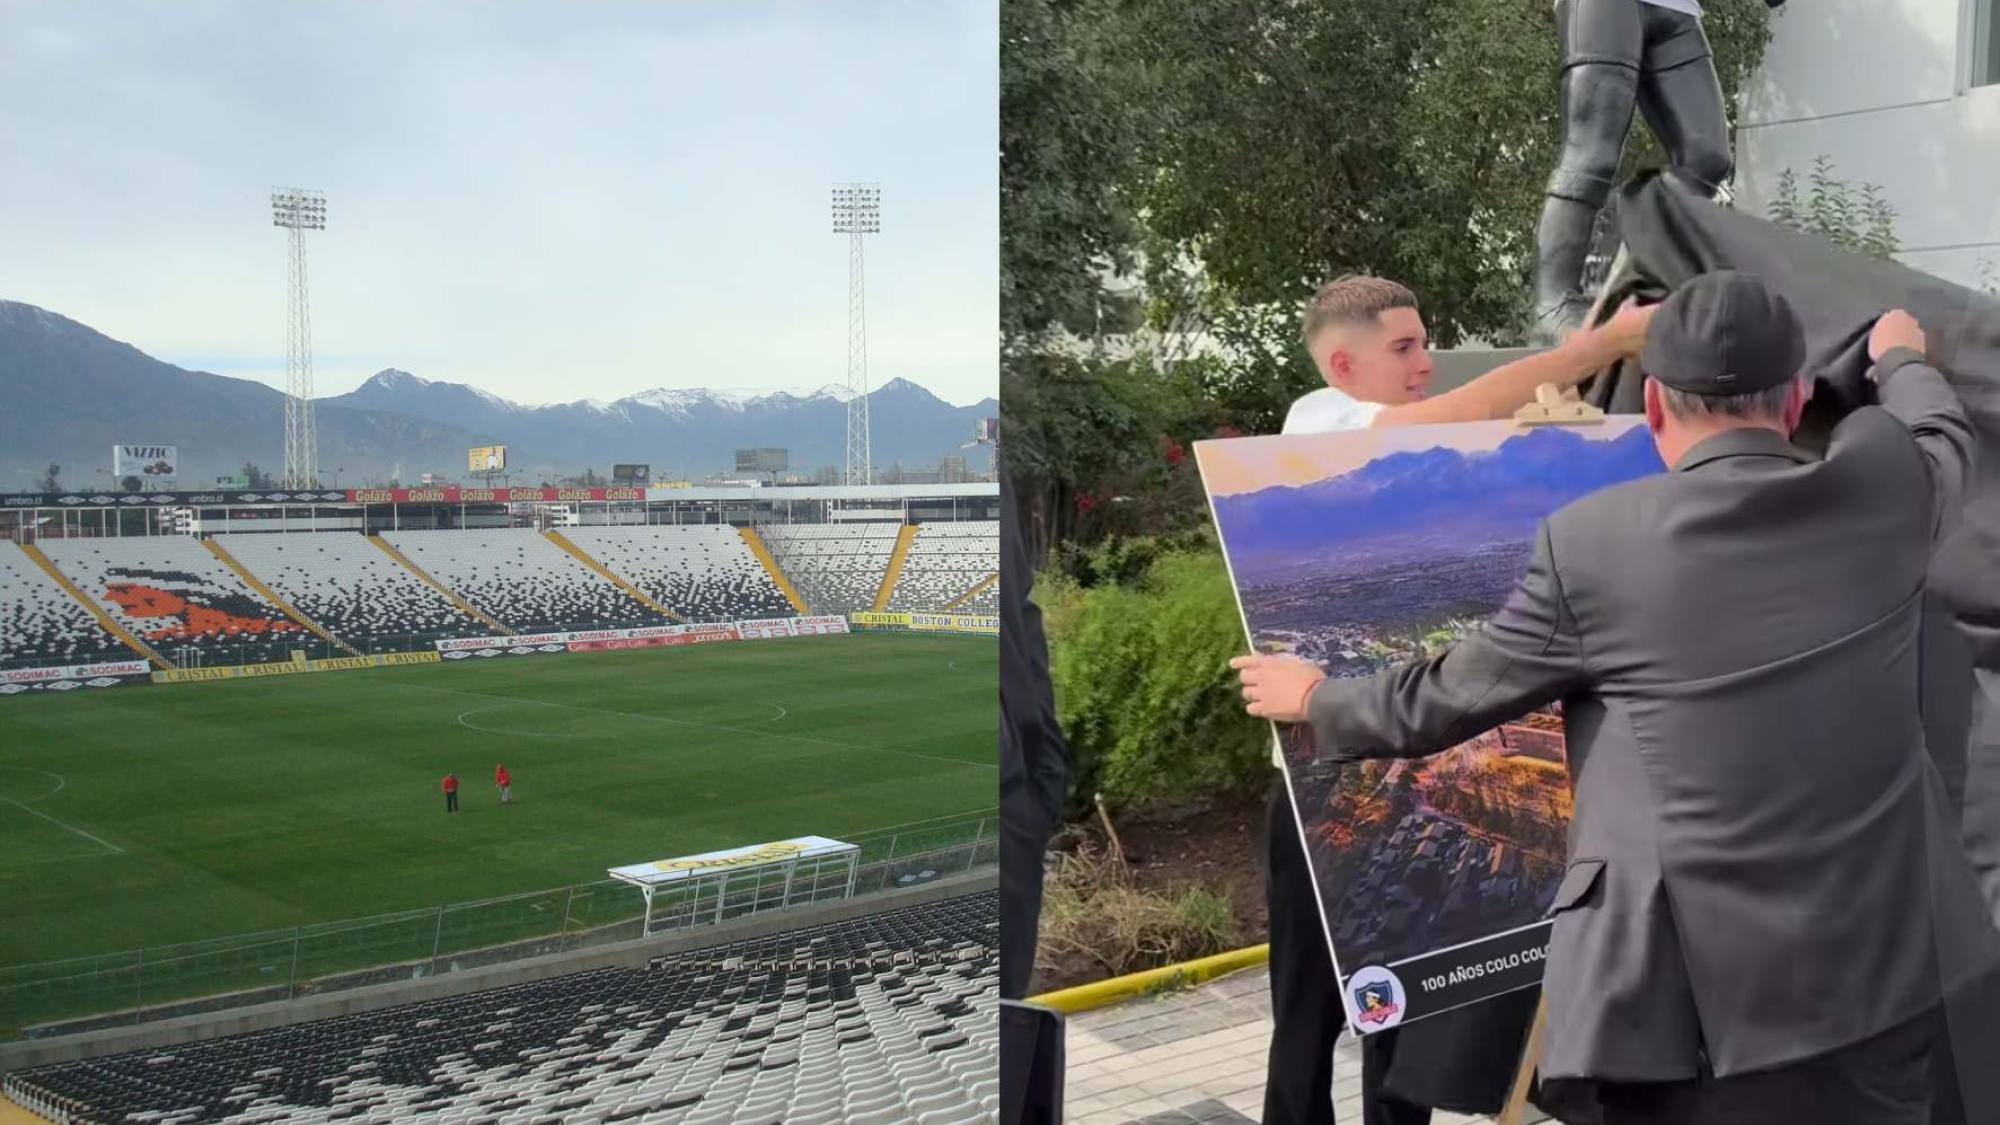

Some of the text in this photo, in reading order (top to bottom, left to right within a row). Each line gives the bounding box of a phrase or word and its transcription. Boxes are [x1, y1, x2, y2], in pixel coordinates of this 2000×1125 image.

[356, 489, 393, 502] Golazo
[408, 489, 444, 502] Golazo
[460, 488, 495, 501] Golazo
[509, 489, 543, 501] Golazo
[558, 488, 591, 501] Golazo
[606, 488, 639, 500] Golazo
[864, 614, 905, 623] CRISTAL
[912, 616, 952, 626] BOSTON
[516, 634, 559, 645] SODIMAC
[579, 631, 617, 640] SODIMAC
[453, 639, 496, 649] SODIMAC
[316, 657, 372, 670] CRISTAL
[385, 651, 439, 664] CRISTAL
[89, 664, 143, 676] SODIMAC
[166, 667, 225, 681] CRISTAL
[243, 662, 302, 676] CRISTAL
[6, 670, 62, 682] SODIMAC
[1421, 975, 1447, 992] 100
[1449, 963, 1485, 986] AÑOS
[1486, 953, 1520, 974] COLO
